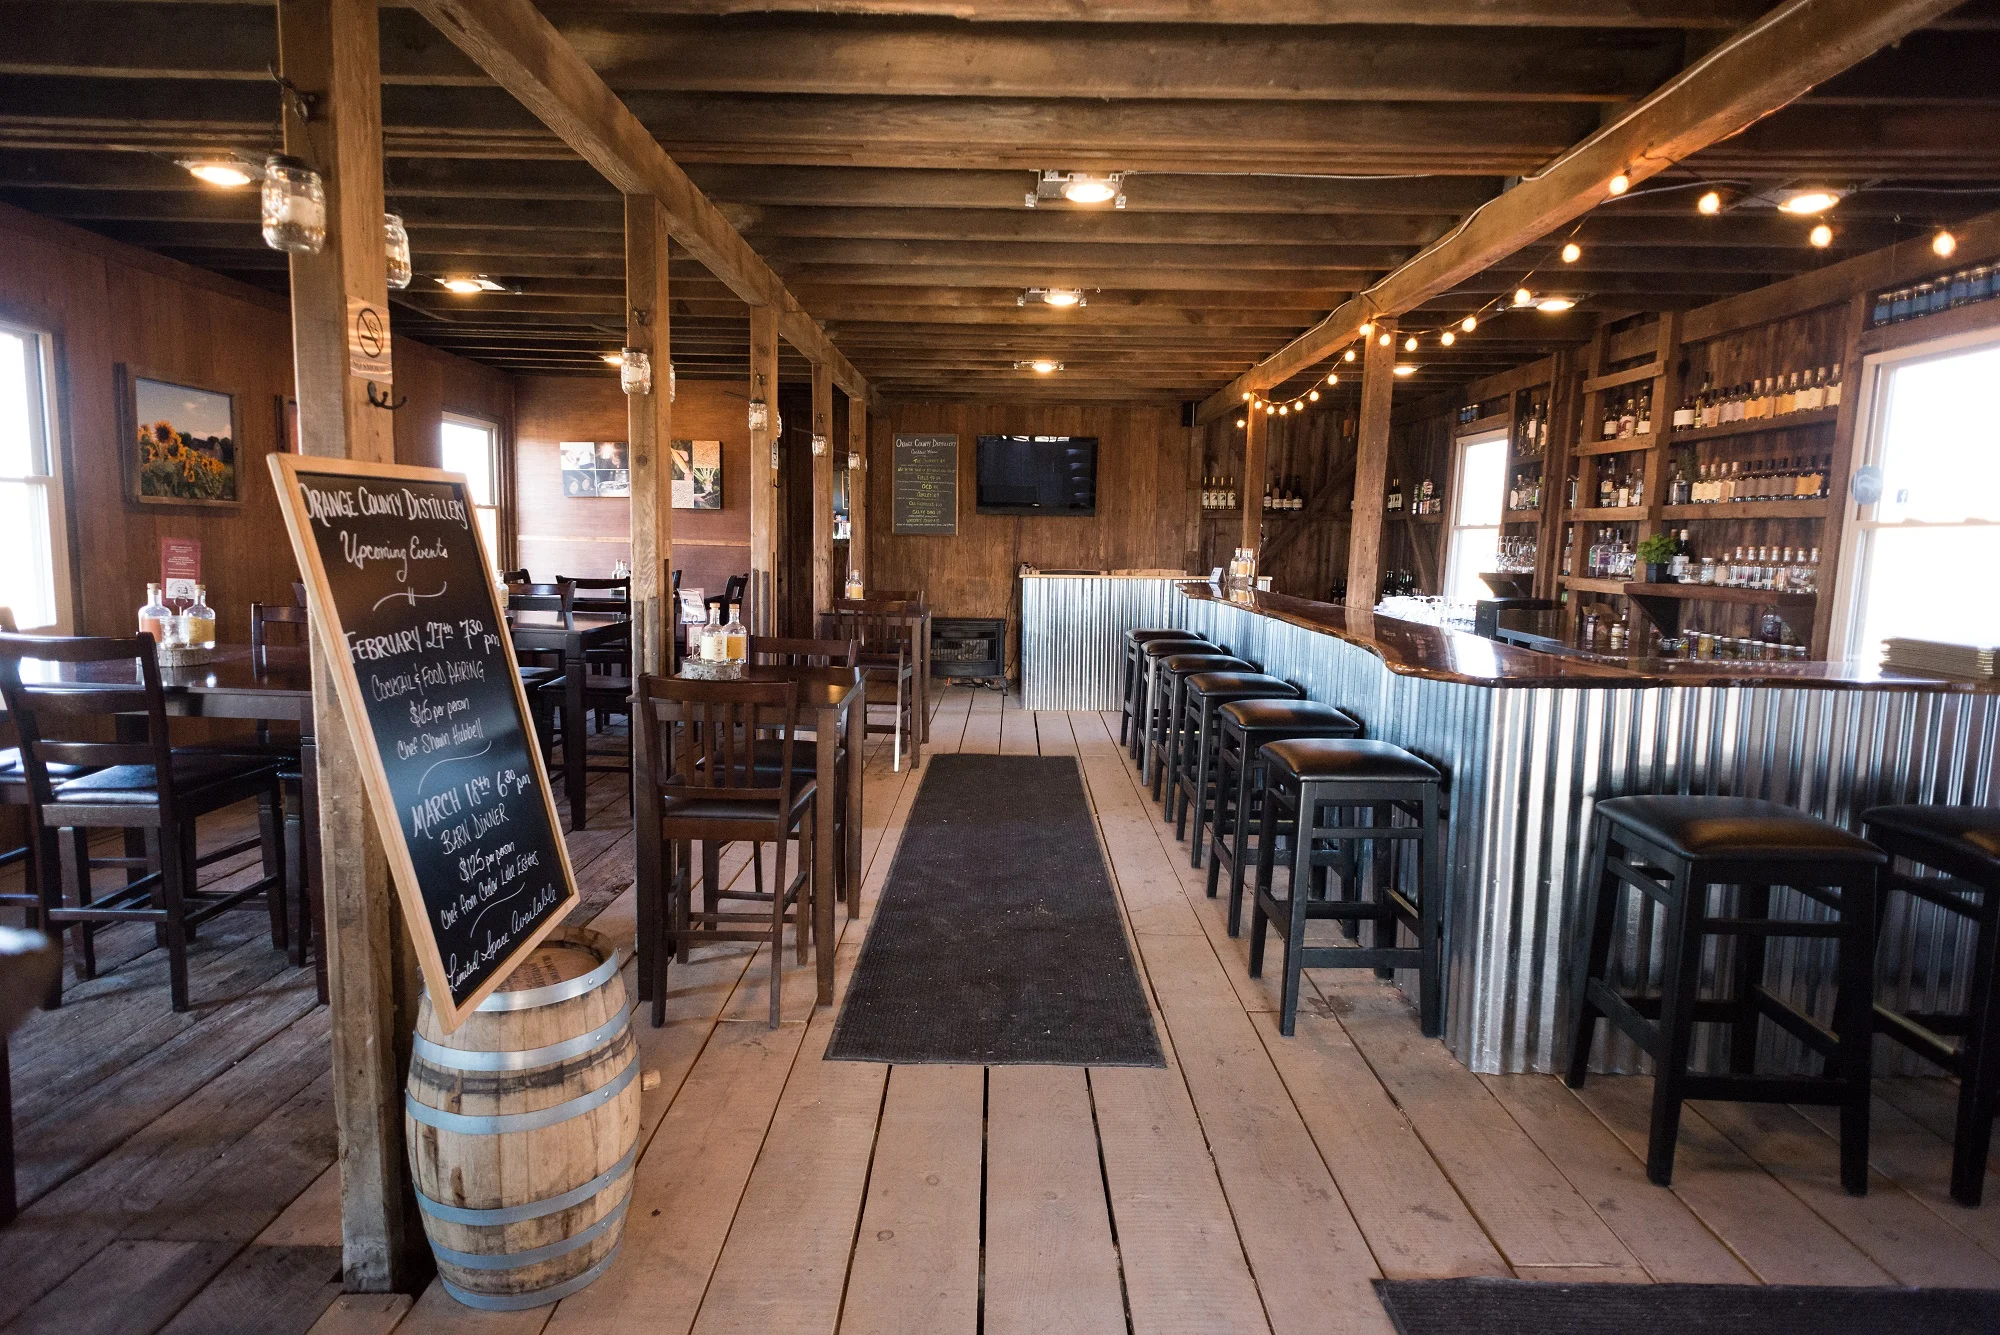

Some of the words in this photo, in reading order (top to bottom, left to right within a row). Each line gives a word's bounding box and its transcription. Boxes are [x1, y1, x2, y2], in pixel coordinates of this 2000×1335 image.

[358, 486, 403, 516] COUNTY
[402, 488, 468, 530] DISTILLERY
[340, 530, 408, 582] Upcoming
[410, 536, 448, 560] Events
[344, 626, 422, 664] FEBRUARY
[426, 621, 454, 650] 27th
[371, 672, 416, 702] COCKTAIL
[422, 663, 446, 688] FOOD
[446, 660, 485, 684] PAIRING
[432, 706, 444, 724] per
[448, 698, 470, 720] person
[397, 737, 418, 760] Chef
[422, 731, 450, 754] Shawn
[452, 718, 484, 746] Hubbell
[412, 788, 461, 840] MARCH
[465, 776, 490, 806] 18th
[516, 774, 531, 794] pm
[440, 819, 472, 854] BARN
[471, 803, 510, 840] DINNER
[458, 848, 485, 883] $125
[485, 853, 495, 872] per
[496, 841, 516, 864] person
[440, 902, 458, 930] Chef
[460, 894, 478, 915] from
[446, 950, 480, 992] Limited
[480, 930, 510, 960] Space
[511, 883, 557, 934] Available
